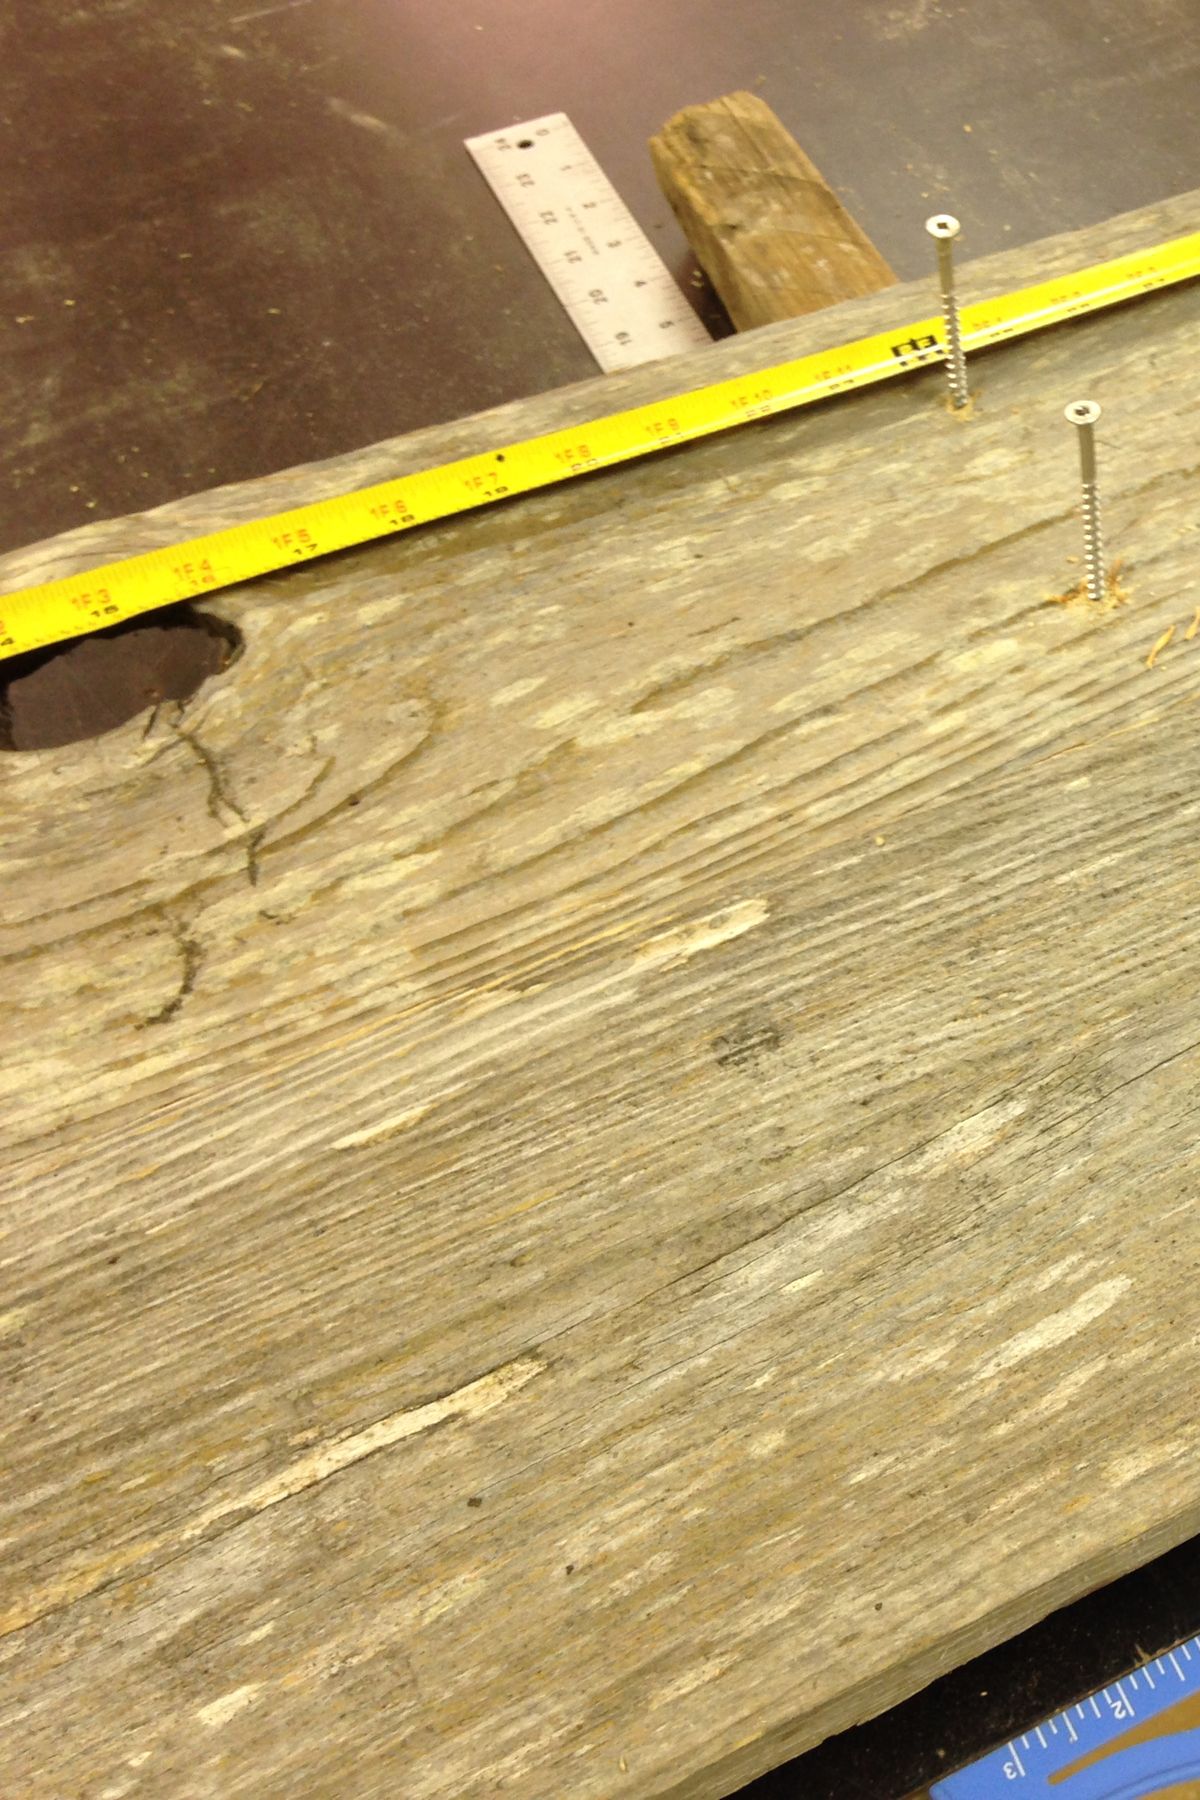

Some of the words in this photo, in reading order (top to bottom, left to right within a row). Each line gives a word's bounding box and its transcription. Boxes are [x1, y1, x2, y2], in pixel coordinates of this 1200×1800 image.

[589, 289, 607, 305] 20
[615, 332, 632, 346] 19
[1111, 1701, 1126, 1719] 2
[1003, 1762, 1017, 1780] 3
